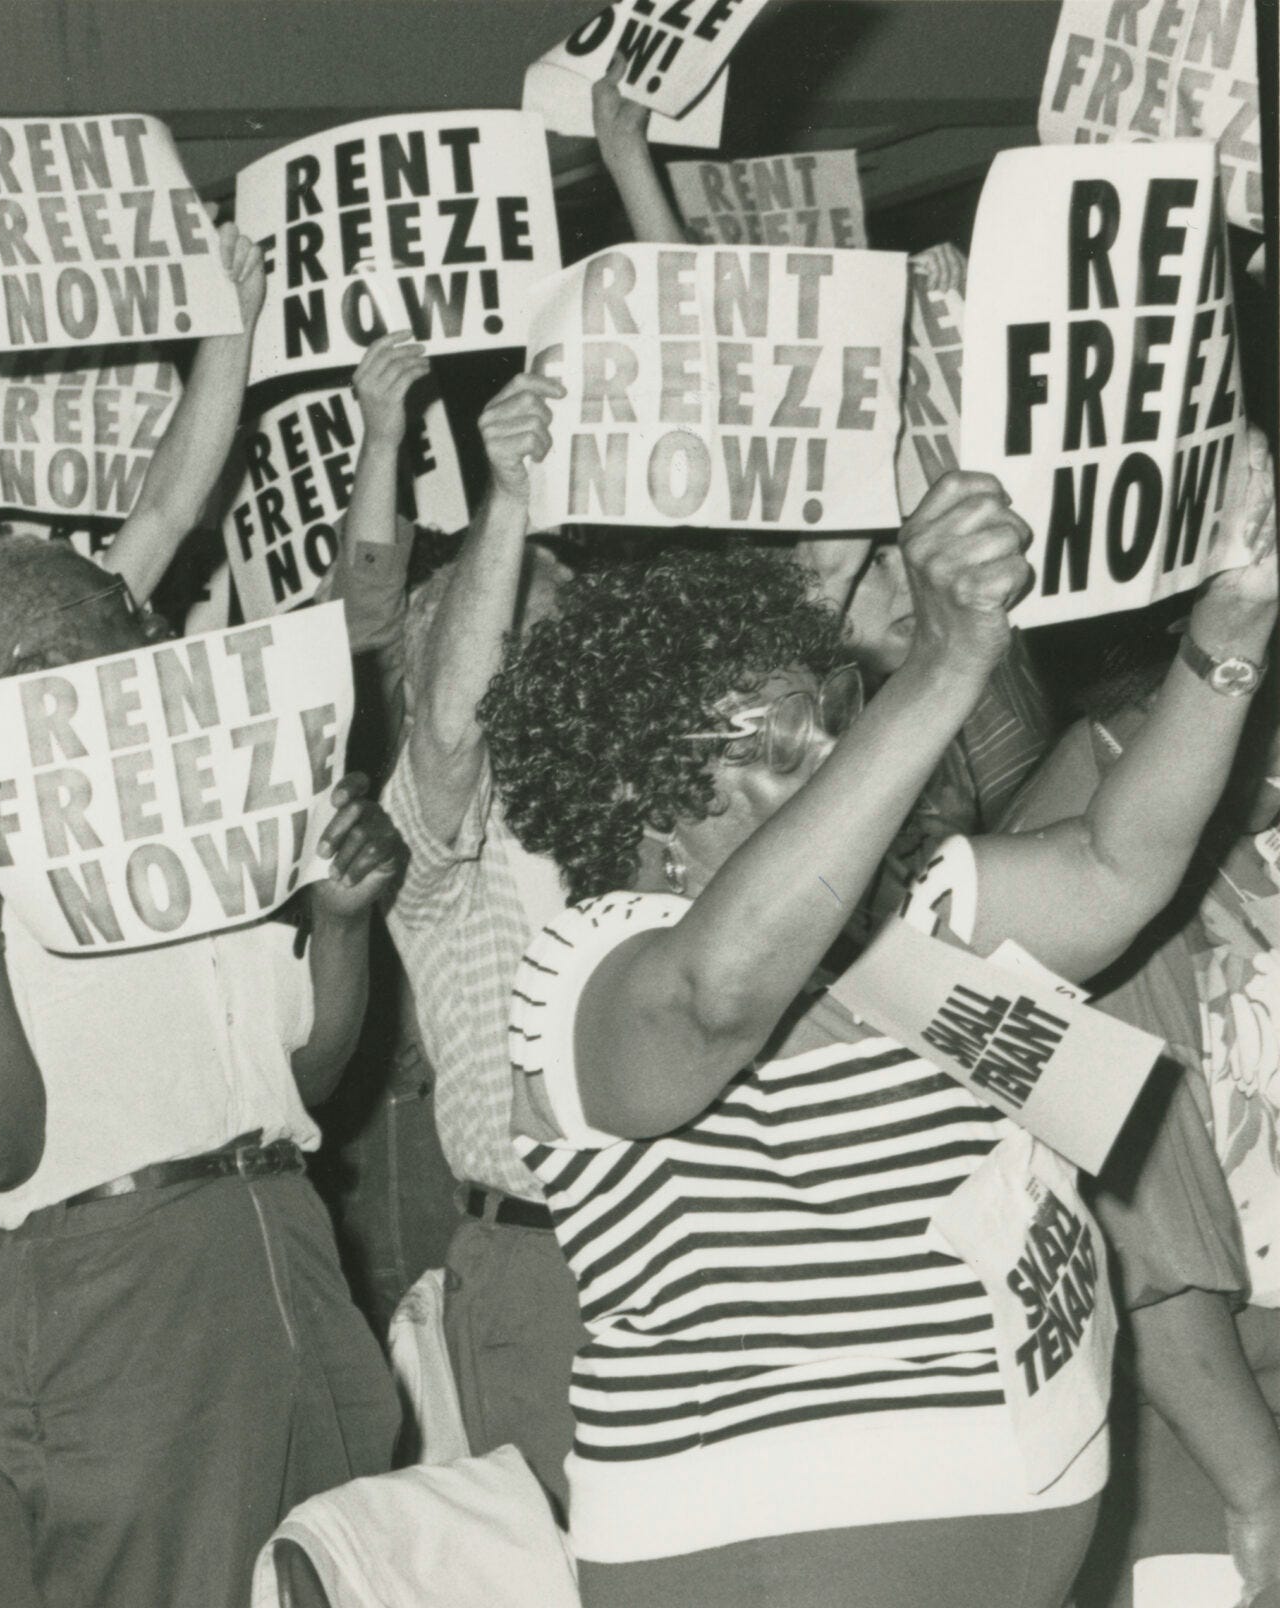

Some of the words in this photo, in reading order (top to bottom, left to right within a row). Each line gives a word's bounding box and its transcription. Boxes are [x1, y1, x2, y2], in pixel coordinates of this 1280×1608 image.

[565, 5, 684, 94] OW!
[1105, 0, 1245, 70] REN
[1050, 33, 1258, 162] FREEZ
[286, 127, 480, 223] RENT
[701, 155, 818, 213] RENT
[1068, 178, 1228, 312] REN
[1, 263, 192, 346] NOW!
[283, 270, 504, 359] NOW!
[581, 250, 834, 339] RENT
[1004, 305, 1244, 457] FREEZ
[246, 393, 355, 489] REN
[568, 431, 827, 525] NOW!
[1041, 433, 1235, 598] NOW!
[266, 523, 339, 605] NO
[19, 625, 274, 768] RENT
[46, 808, 308, 947] NOW!
[921, 984, 1012, 1070] SMALL
[970, 995, 1070, 1110] TENANT
[1006, 1188, 1083, 1330] SMALL
